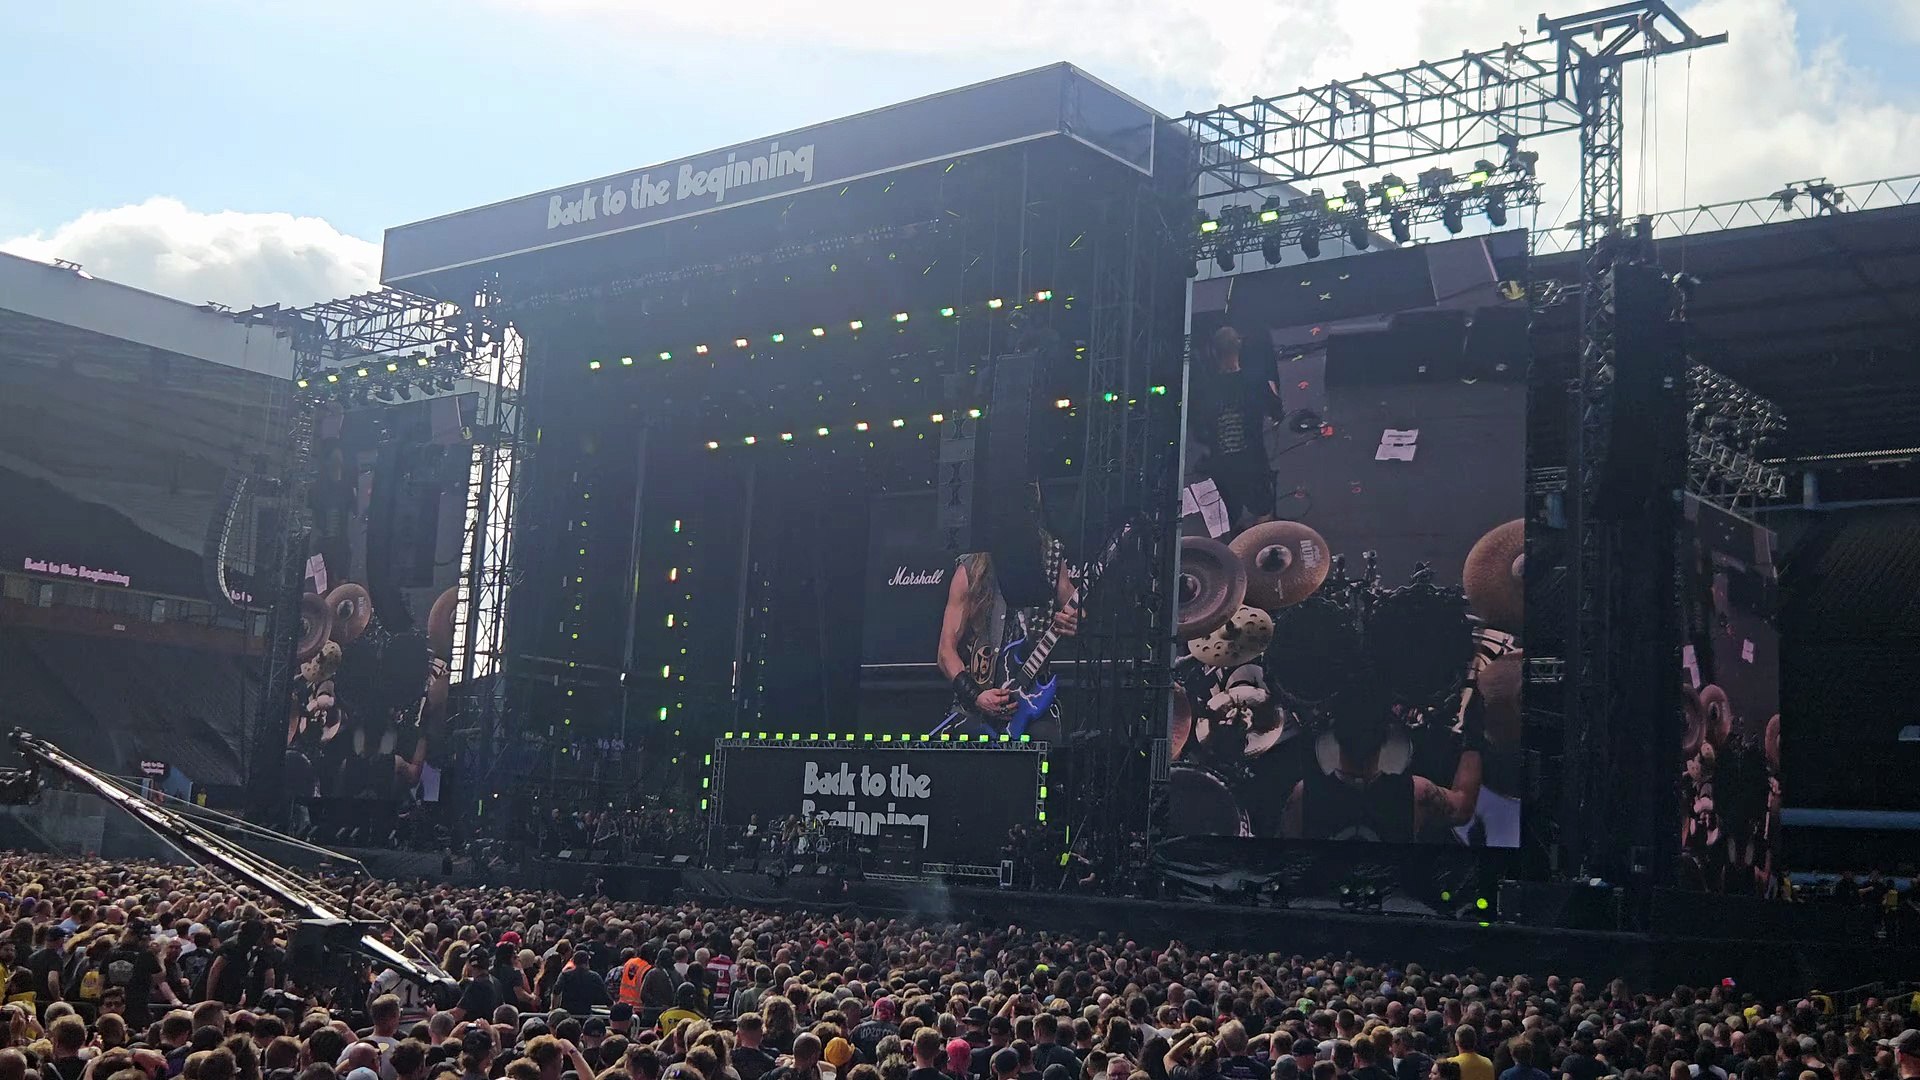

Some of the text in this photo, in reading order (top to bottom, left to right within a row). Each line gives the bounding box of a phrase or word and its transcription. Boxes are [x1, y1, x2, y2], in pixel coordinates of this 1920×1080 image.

[547, 142, 815, 229] Back to the Beginning
[888, 566, 945, 586] Marshall
[803, 761, 931, 799] Back to the
